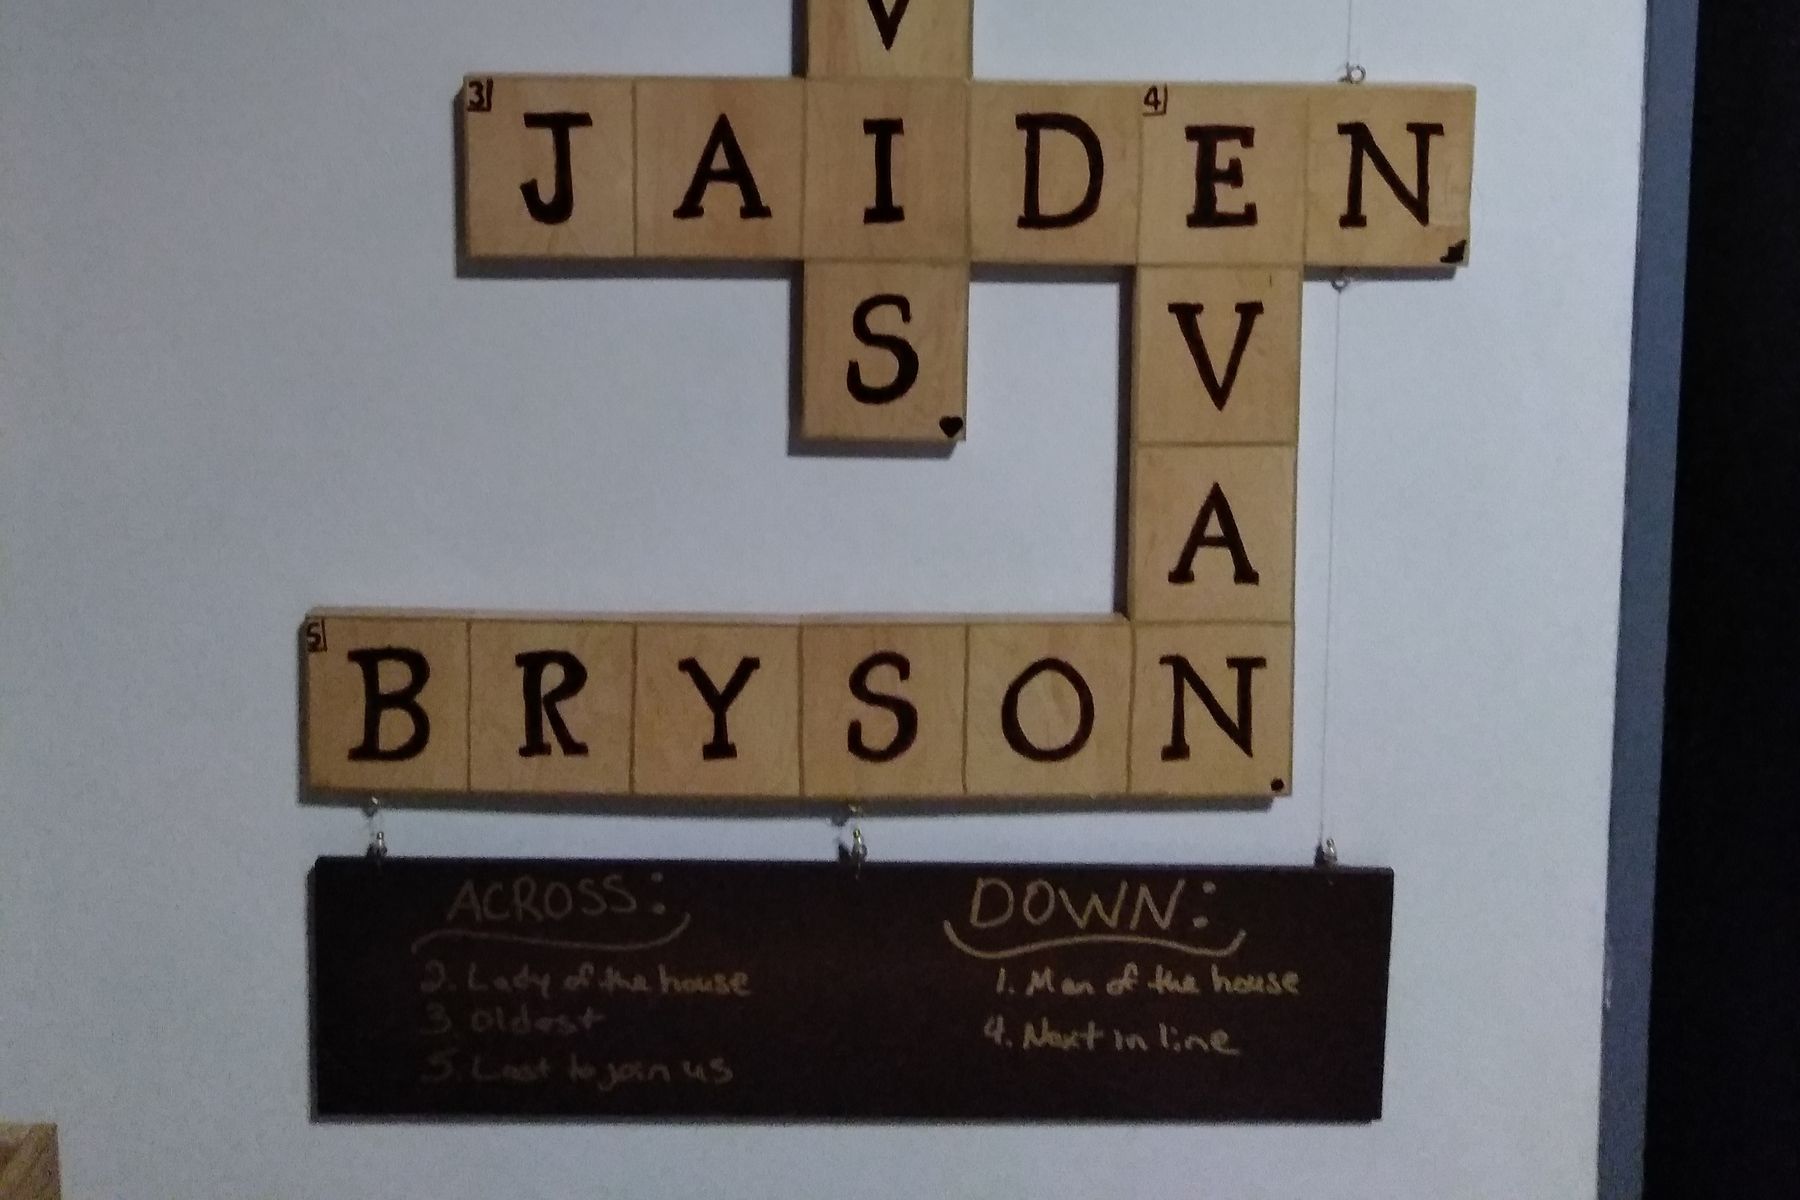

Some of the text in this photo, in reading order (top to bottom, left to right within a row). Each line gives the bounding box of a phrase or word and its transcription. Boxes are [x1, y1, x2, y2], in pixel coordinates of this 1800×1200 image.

[468, 81, 484, 106] 3
[1144, 86, 1161, 111] 4
[520, 112, 1445, 230] JAIDEN
[346, 646, 1268, 762] BRYSON
[969, 876, 1218, 930] DOWN:
[658, 962, 752, 997] house
[1210, 962, 1301, 997] house
[1113, 1028, 1149, 1052] in
[1159, 1020, 1241, 1057] line
[682, 1056, 735, 1085] us
